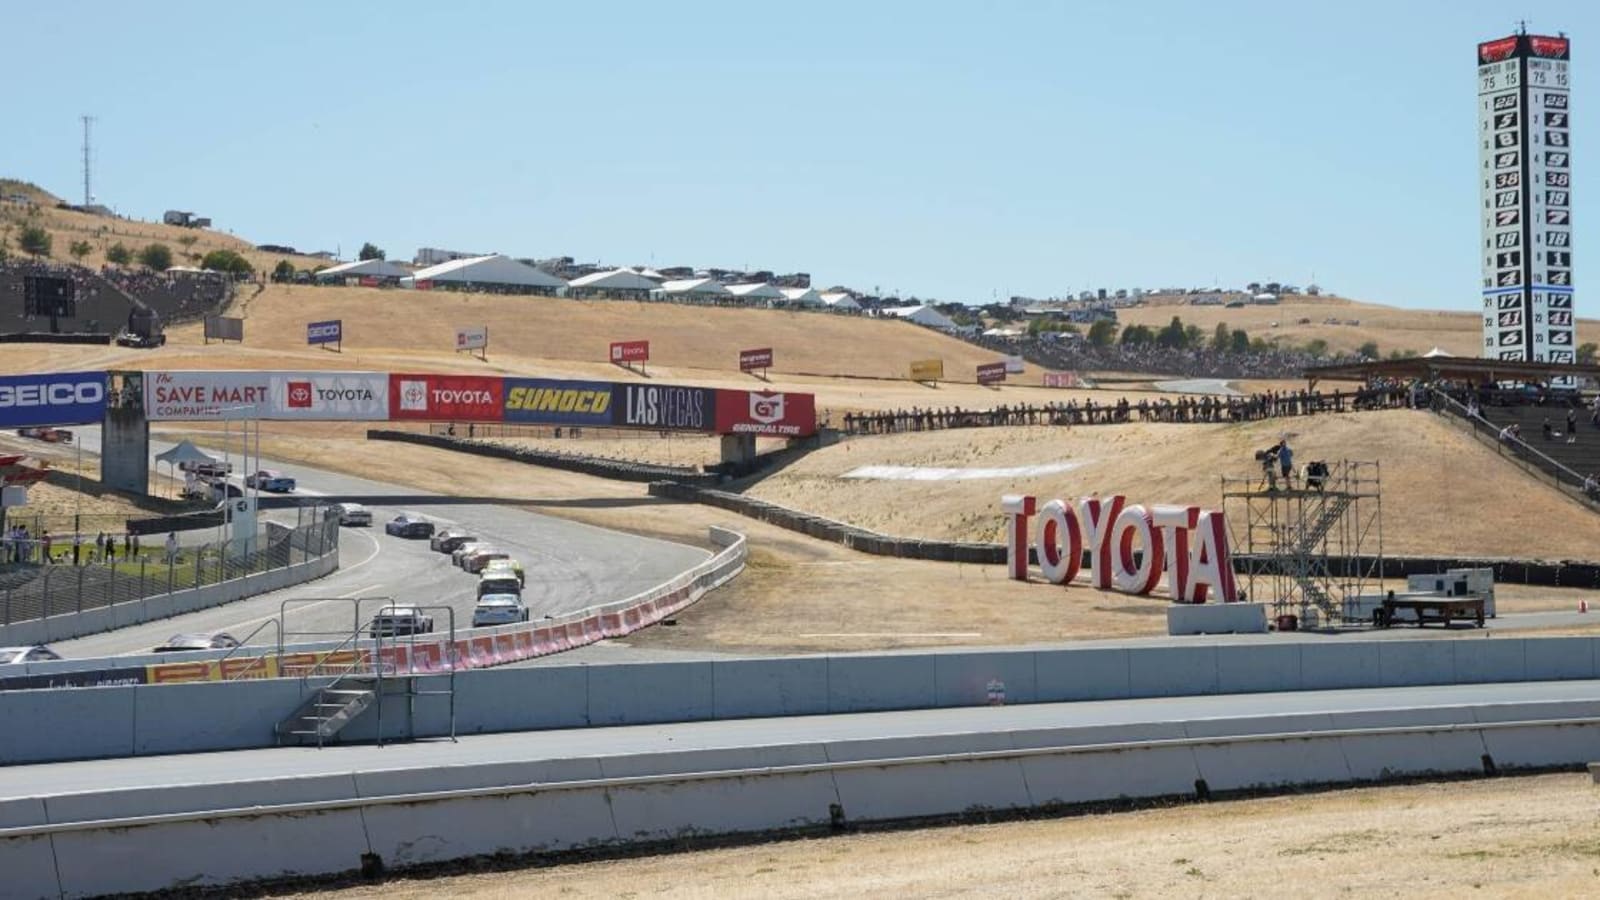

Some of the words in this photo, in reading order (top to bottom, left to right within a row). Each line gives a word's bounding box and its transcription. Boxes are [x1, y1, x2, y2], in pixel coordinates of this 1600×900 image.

[1483, 77, 1495, 89] 75
[1505, 73, 1516, 85] 15
[1533, 72, 1546, 83] 75
[1556, 74, 1567, 85] 15
[1498, 113, 1514, 129] 5
[1549, 113, 1565, 127] 5
[1499, 132, 1515, 146] 8
[1549, 132, 1565, 146] 8
[1497, 153, 1517, 169] 9
[1547, 154, 1567, 167] 9
[1497, 173, 1518, 188] 38
[1547, 172, 1568, 186] 38
[1498, 192, 1516, 207] 19
[1548, 192, 1566, 205] 19
[1498, 211, 1518, 225] 7
[1548, 211, 1568, 224] 7
[1498, 233, 1518, 248] 18
[1548, 233, 1567, 247] 18
[1504, 253, 1514, 267] 1
[1554, 252, 1563, 266] 1
[1500, 272, 1517, 285] 4
[1550, 272, 1567, 285] 4
[1499, 295, 1520, 308] 17
[1550, 295, 1569, 306] 17
[1500, 312, 1520, 326] 41
[1550, 313, 1569, 325] 41
[308, 325, 339, 338] GEICO
[1502, 332, 1519, 345] 6
[1552, 332, 1568, 344] 6
[1551, 352, 1572, 363] 12
[156, 374, 173, 384] The
[156, 386, 205, 403] SAVE
[212, 386, 267, 402] MART
[317, 389, 373, 401] TOYOTA
[432, 390, 493, 404] TOYOTA
[506, 387, 611, 414] SUNOCO
[755, 401, 779, 417] GT
[732, 423, 777, 433] GENERAL
[779, 425, 801, 434] TIRE
[1001, 494, 1238, 604] TOYOTA
